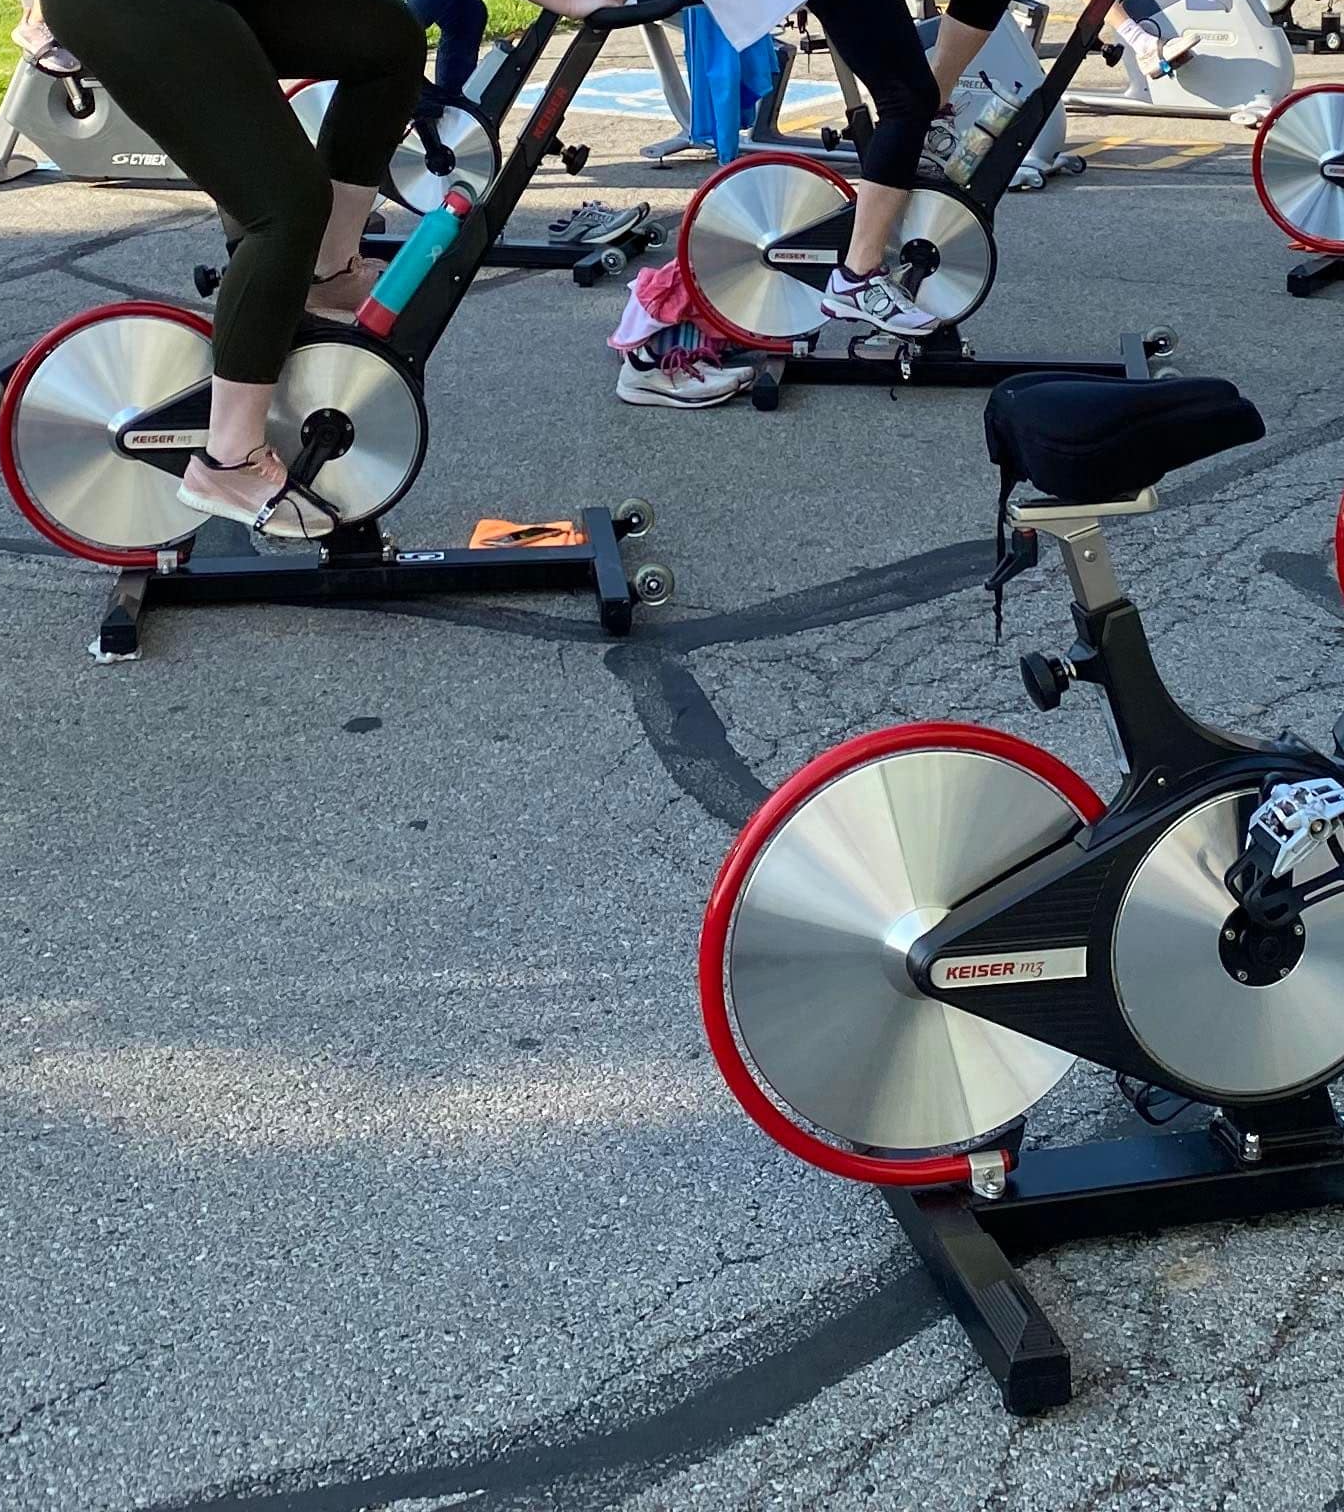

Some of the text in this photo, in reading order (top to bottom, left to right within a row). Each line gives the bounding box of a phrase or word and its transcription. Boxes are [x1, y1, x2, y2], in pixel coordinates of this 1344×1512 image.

[129, 153, 168, 166] CYBEX
[132, 435, 175, 444] KEISER
[946, 962, 1015, 980] KEISER
